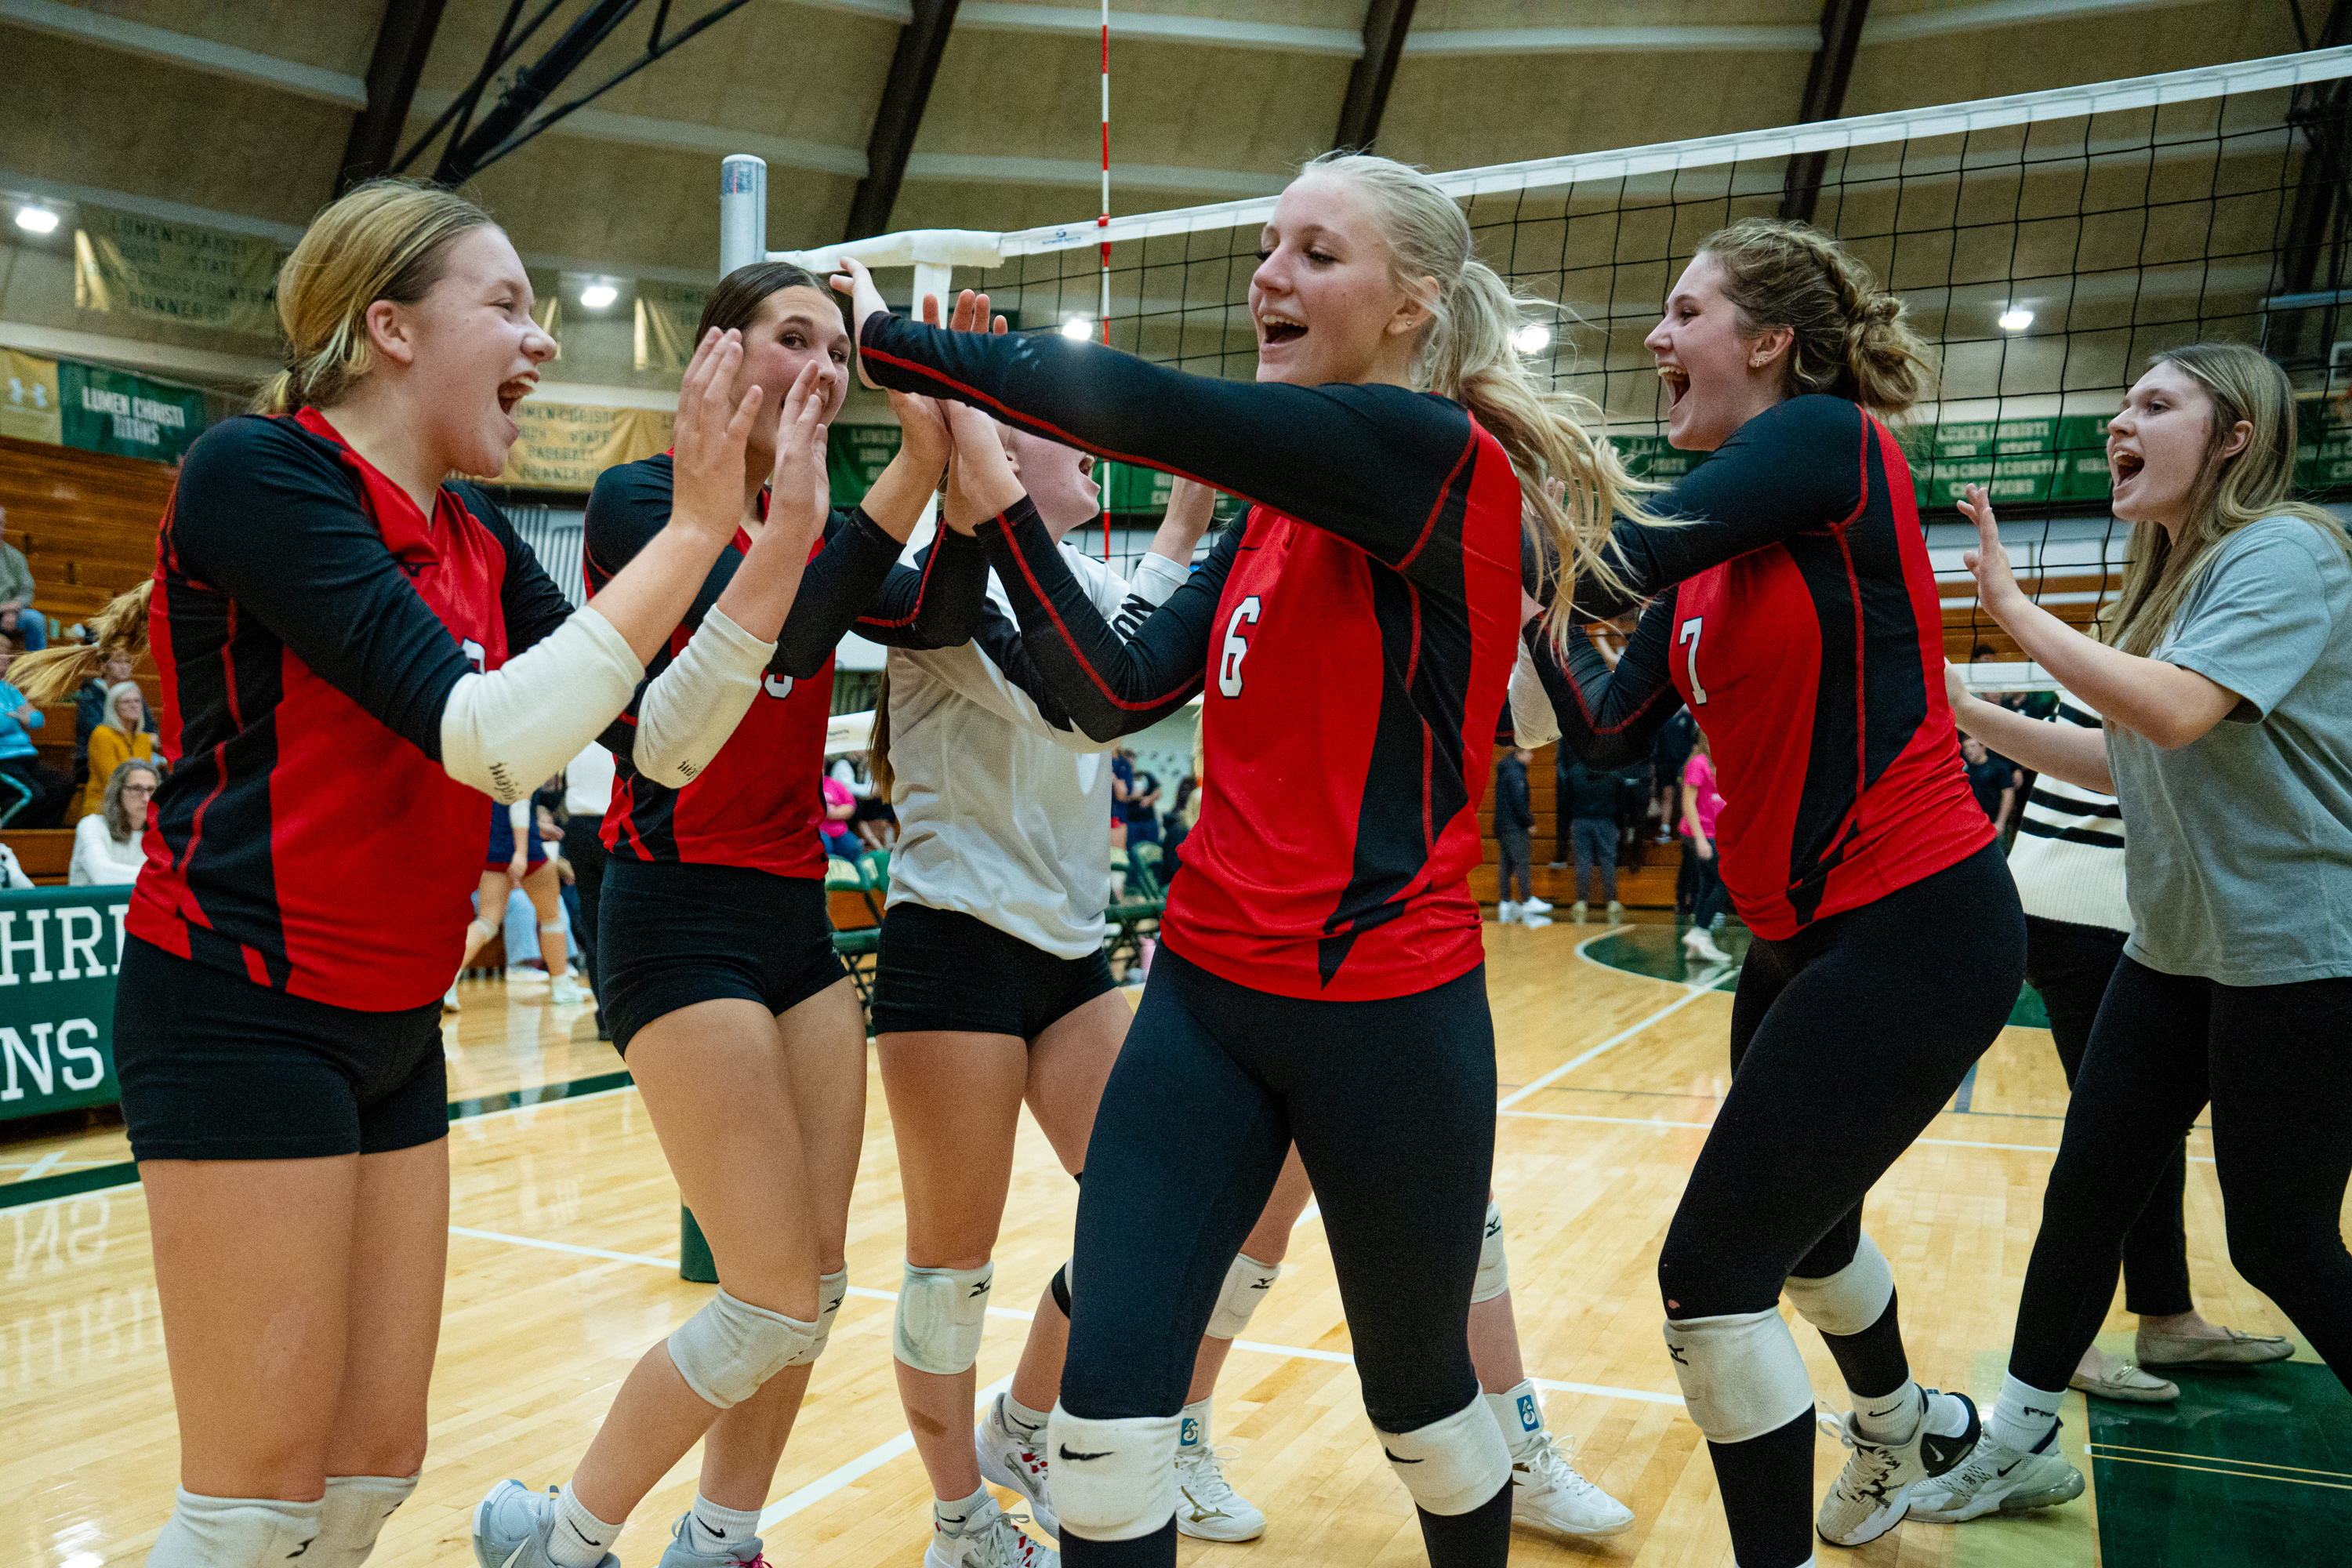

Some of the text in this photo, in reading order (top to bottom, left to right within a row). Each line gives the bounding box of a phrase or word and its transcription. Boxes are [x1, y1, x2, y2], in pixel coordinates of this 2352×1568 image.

[82, 385, 186, 428] LUMEN CHRISTI
[1218, 595, 1261, 699] 6
[1679, 615, 1708, 706] 7
[0, 1018, 105, 1102] NS
